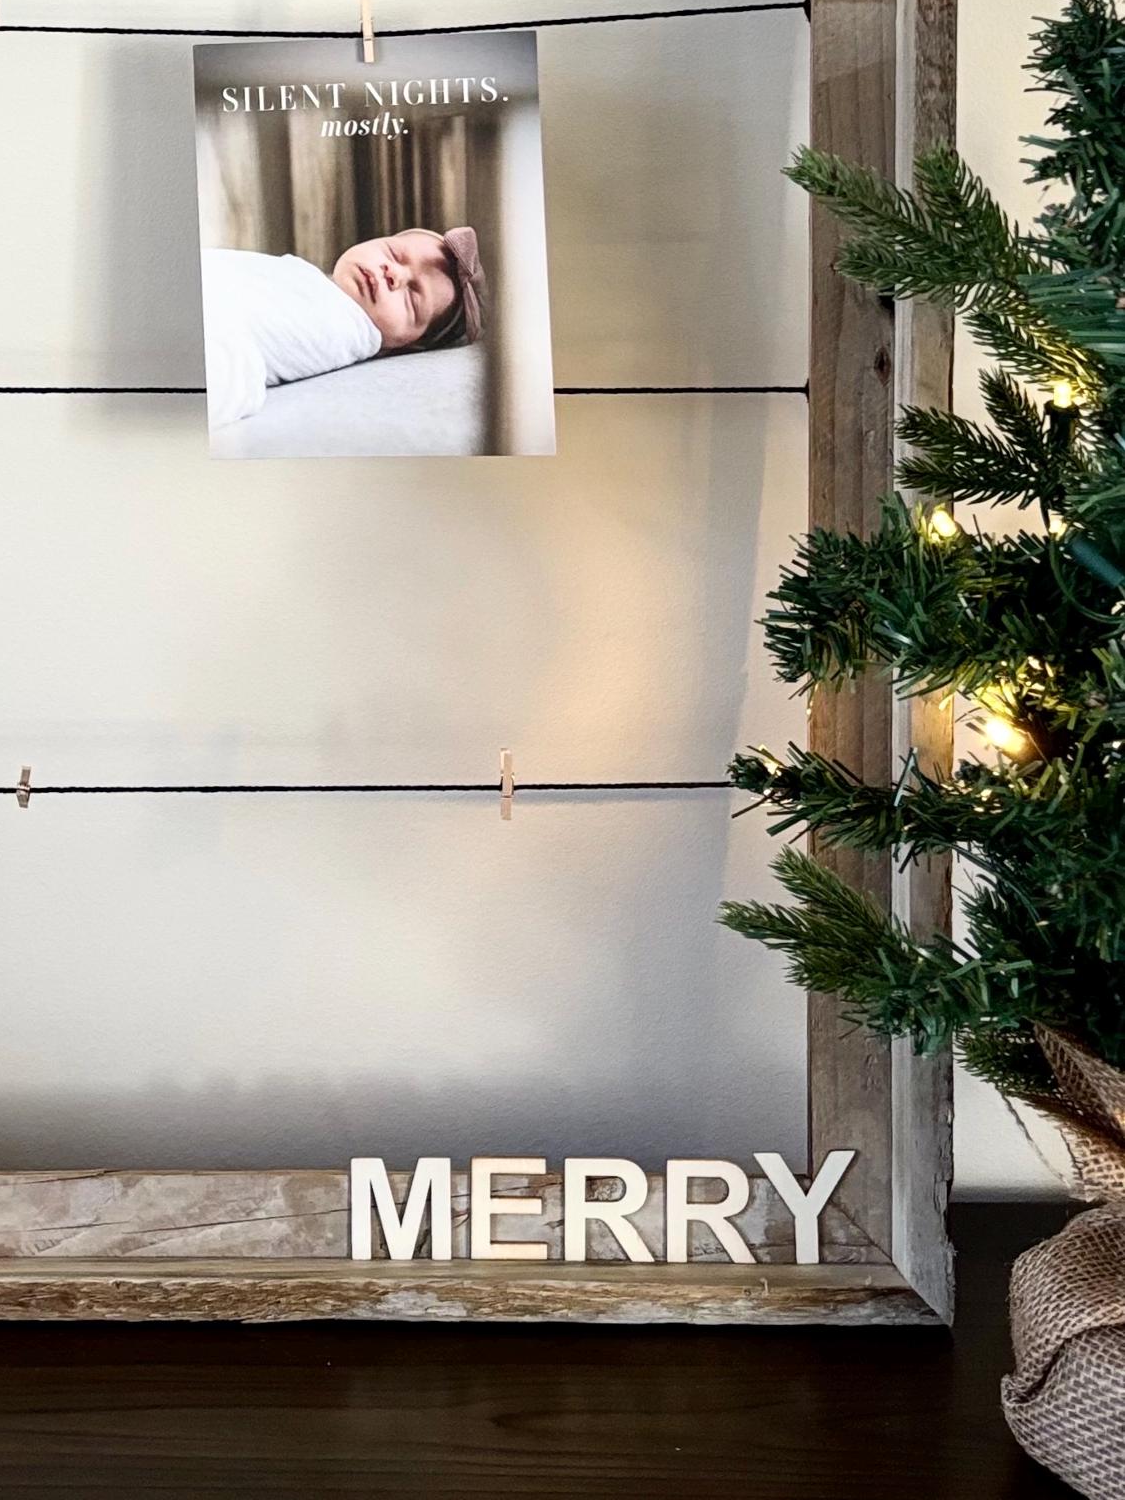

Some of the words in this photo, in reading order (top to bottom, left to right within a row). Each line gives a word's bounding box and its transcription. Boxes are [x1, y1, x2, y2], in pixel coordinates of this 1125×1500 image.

[222, 82, 346, 112] SILENT
[364, 77, 509, 107] NIGHTS.
[321, 112, 409, 140] mostly.
[350, 1149, 855, 1264] MERRY
